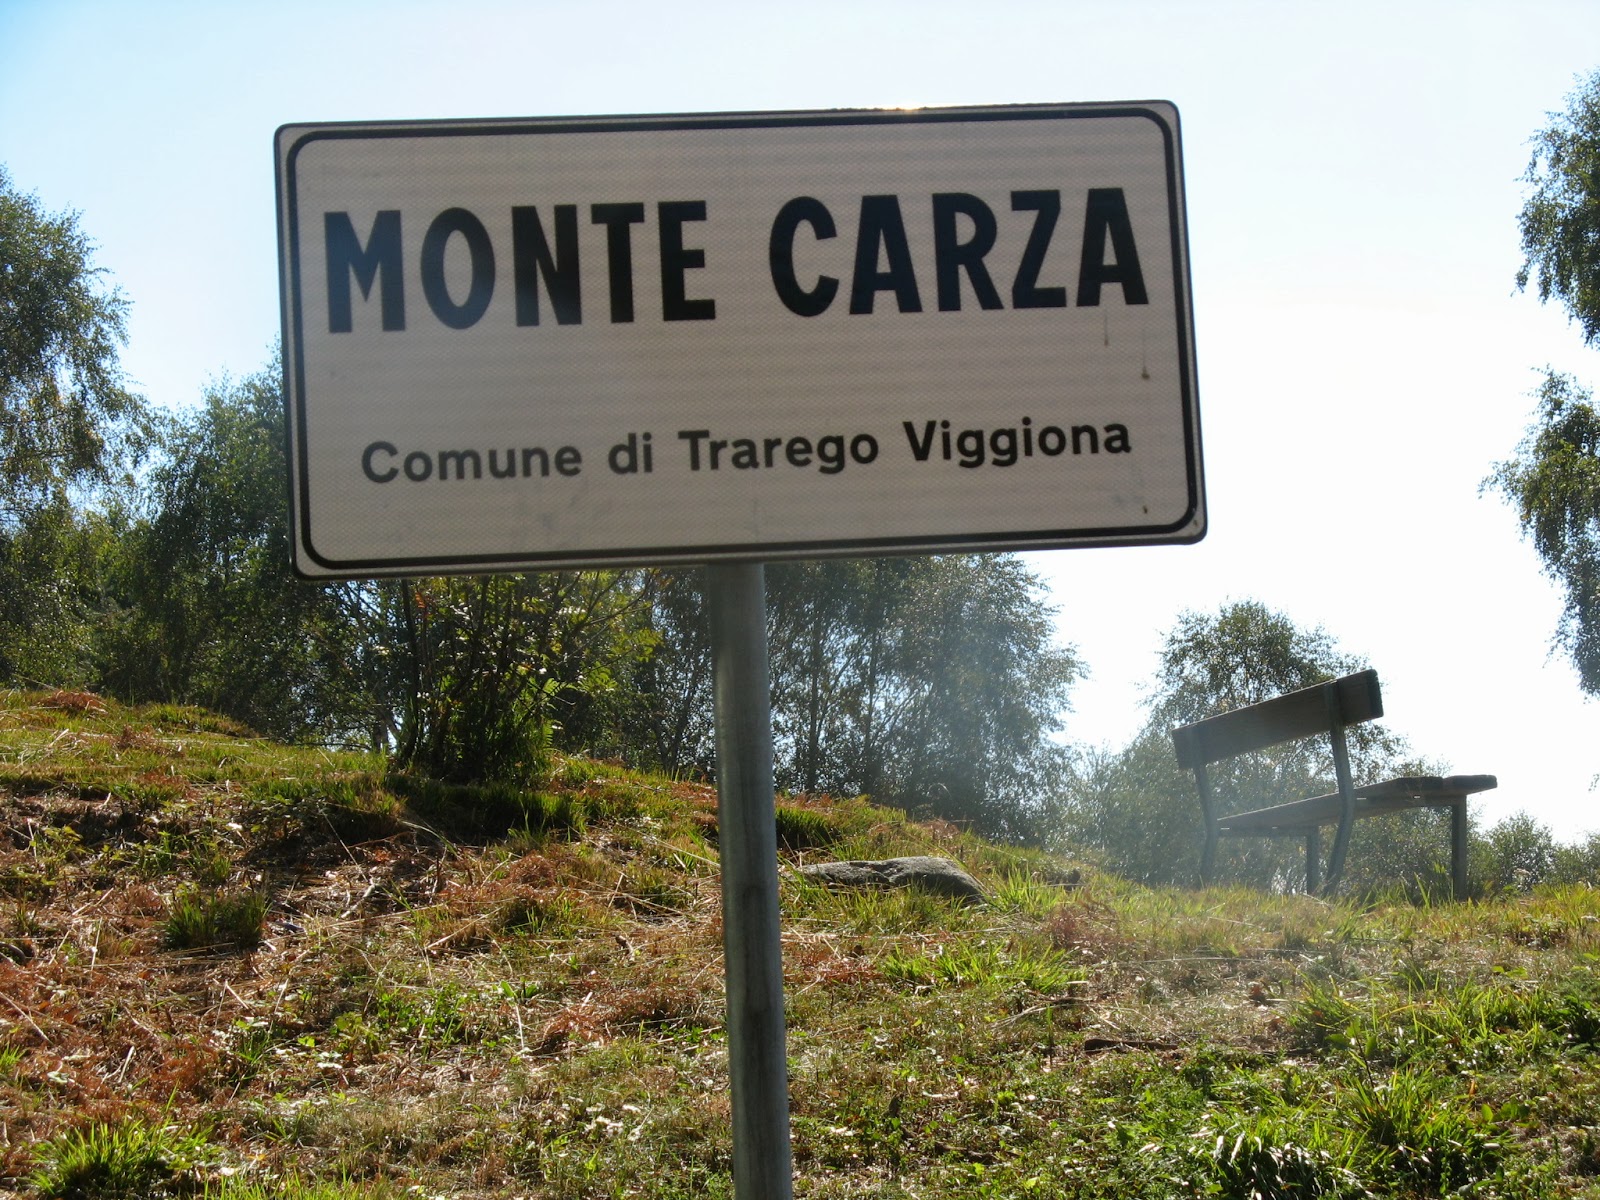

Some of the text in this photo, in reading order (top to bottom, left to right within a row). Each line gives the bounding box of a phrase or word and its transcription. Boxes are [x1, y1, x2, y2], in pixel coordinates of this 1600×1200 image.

[323, 187, 1150, 334] MONTE CARZA
[361, 416, 1133, 484] Comune di Trarego Viggiona
